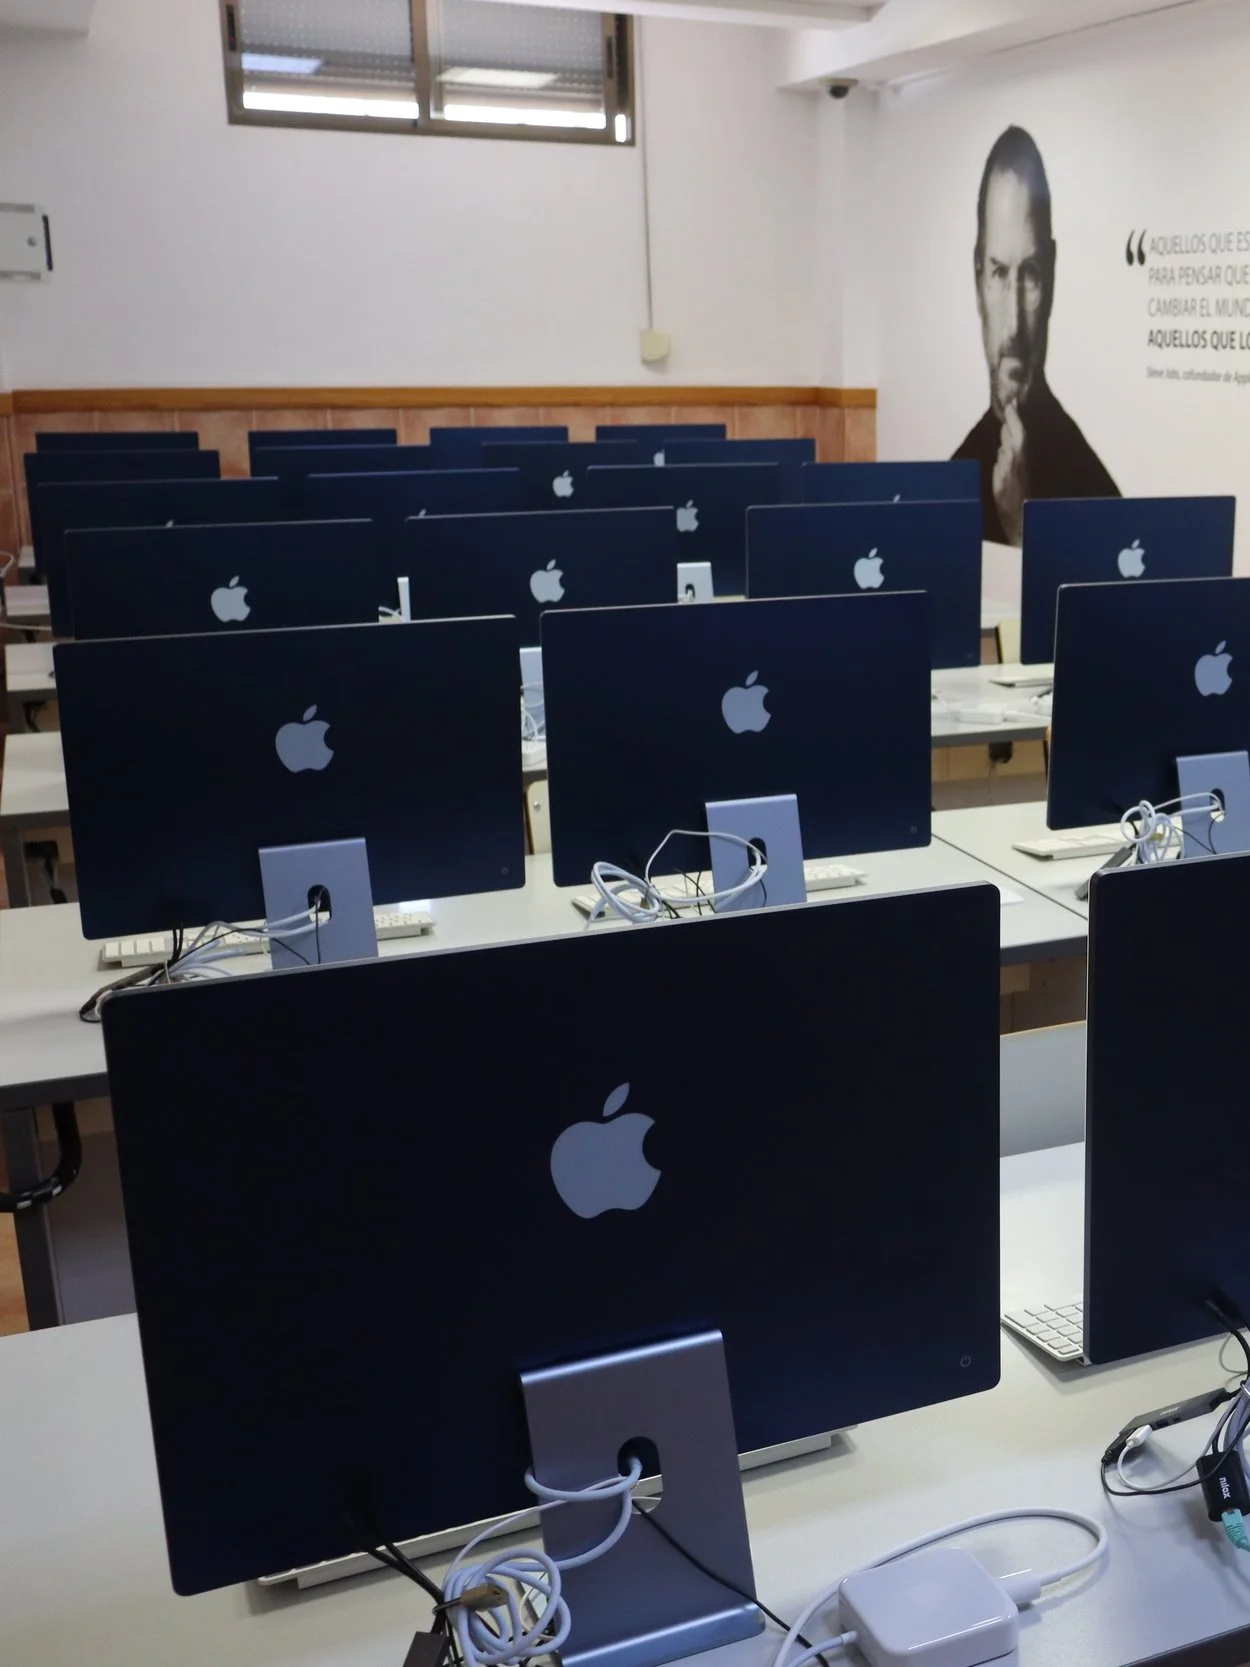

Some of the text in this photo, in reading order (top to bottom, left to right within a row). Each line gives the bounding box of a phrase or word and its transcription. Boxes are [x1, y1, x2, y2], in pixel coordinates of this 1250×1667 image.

[1149, 234, 1206, 256] AQUELLOS
[1208, 231, 1233, 255] QUE
[1148, 266, 1176, 286] PARA
[1178, 265, 1222, 286] PENSAR
[1224, 264, 1250, 287] QUE
[1147, 297, 1197, 318] CAMBIAR
[1199, 297, 1212, 318] EL
[1147, 328, 1208, 350] AQUELLOS
[1210, 330, 1236, 351] QUE
[1218, 1477, 1231, 1500] nilox
